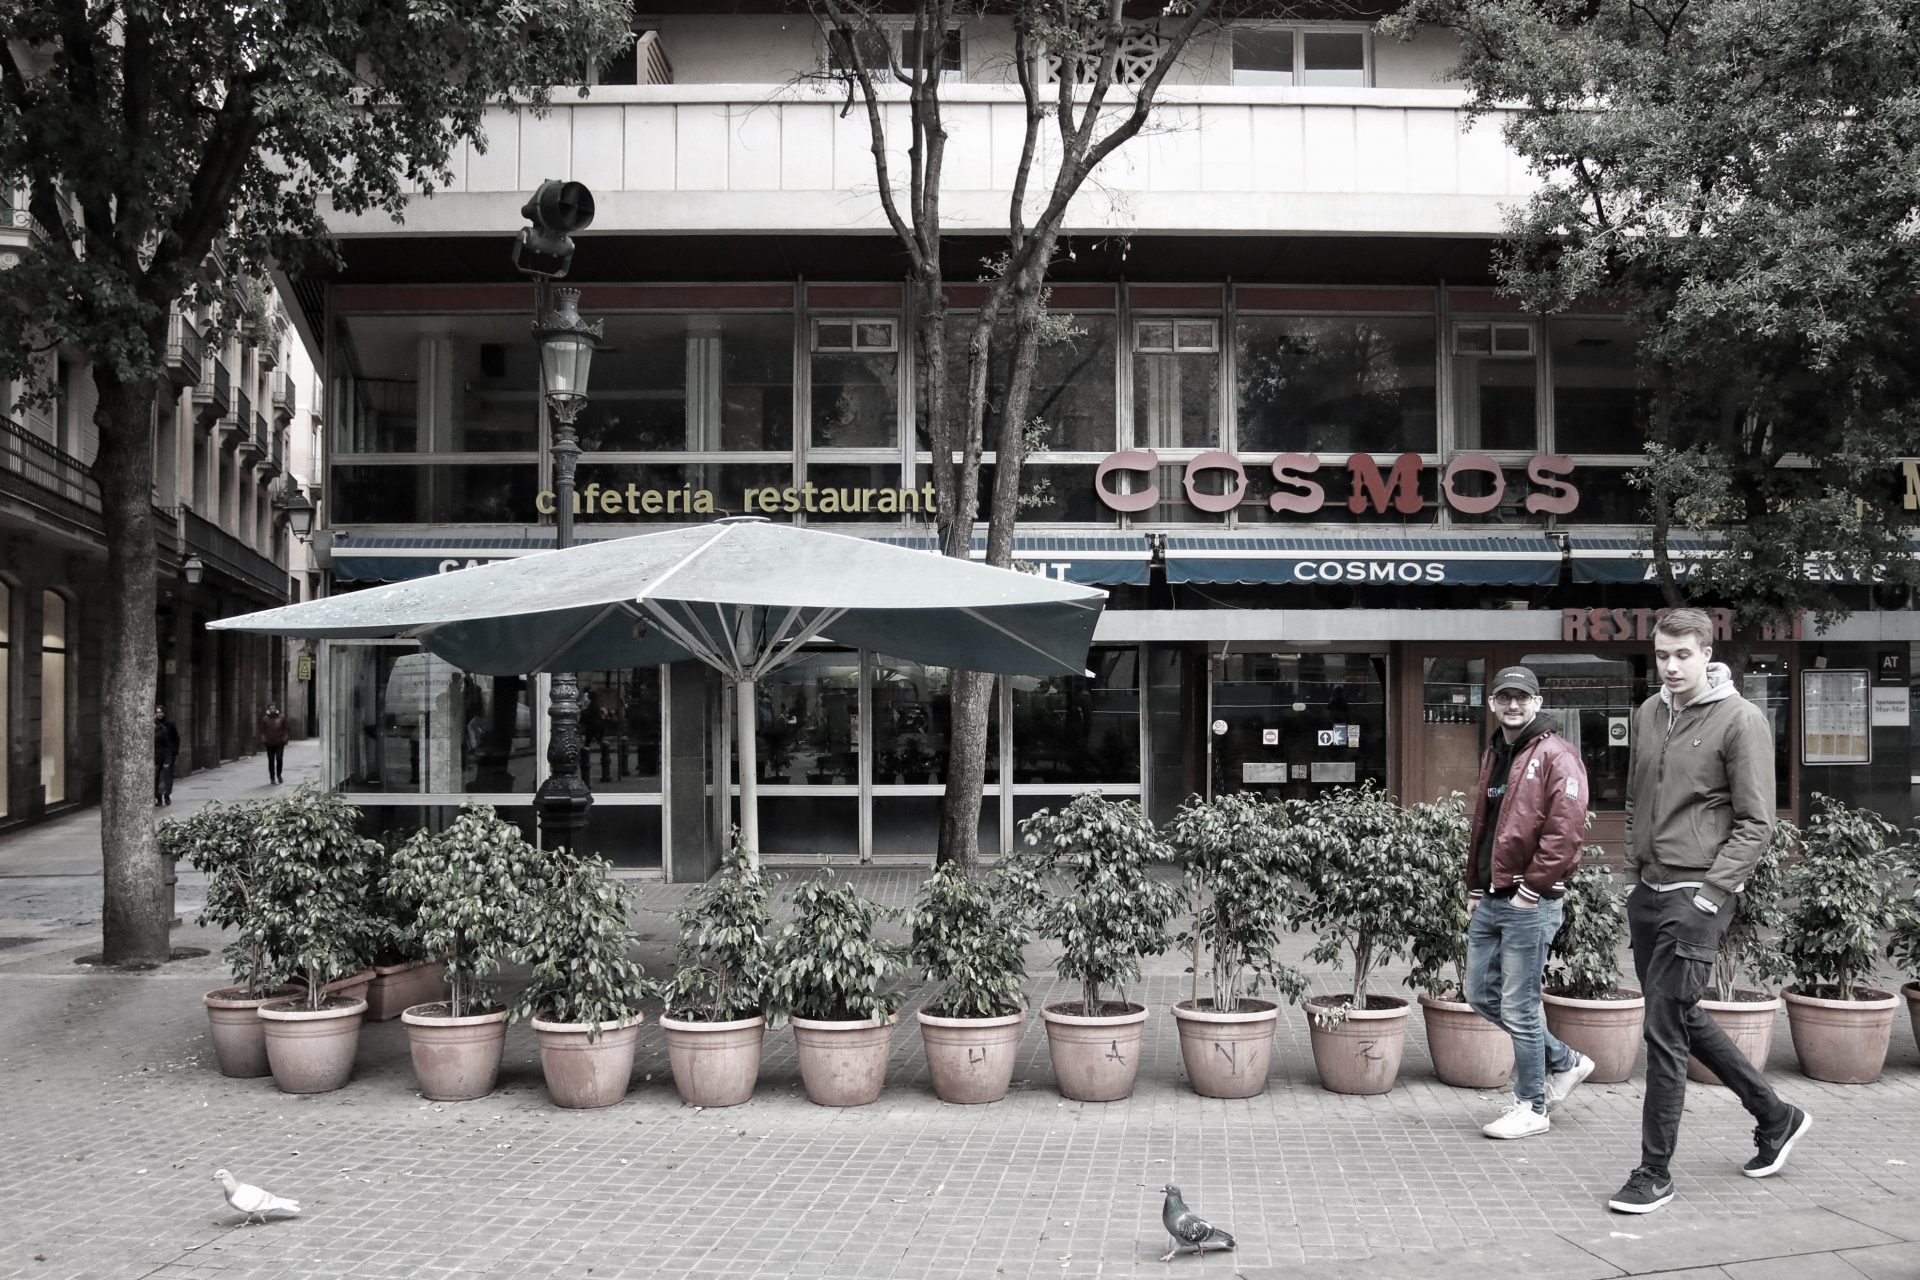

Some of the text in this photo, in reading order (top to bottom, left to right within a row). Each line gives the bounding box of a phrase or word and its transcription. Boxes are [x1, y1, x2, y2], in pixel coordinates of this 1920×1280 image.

[1095, 449, 1580, 514] COSMOS
[744, 481, 937, 513] restaurant
[1293, 561, 1446, 582] COSMOS
[1883, 656, 1899, 668] AT
